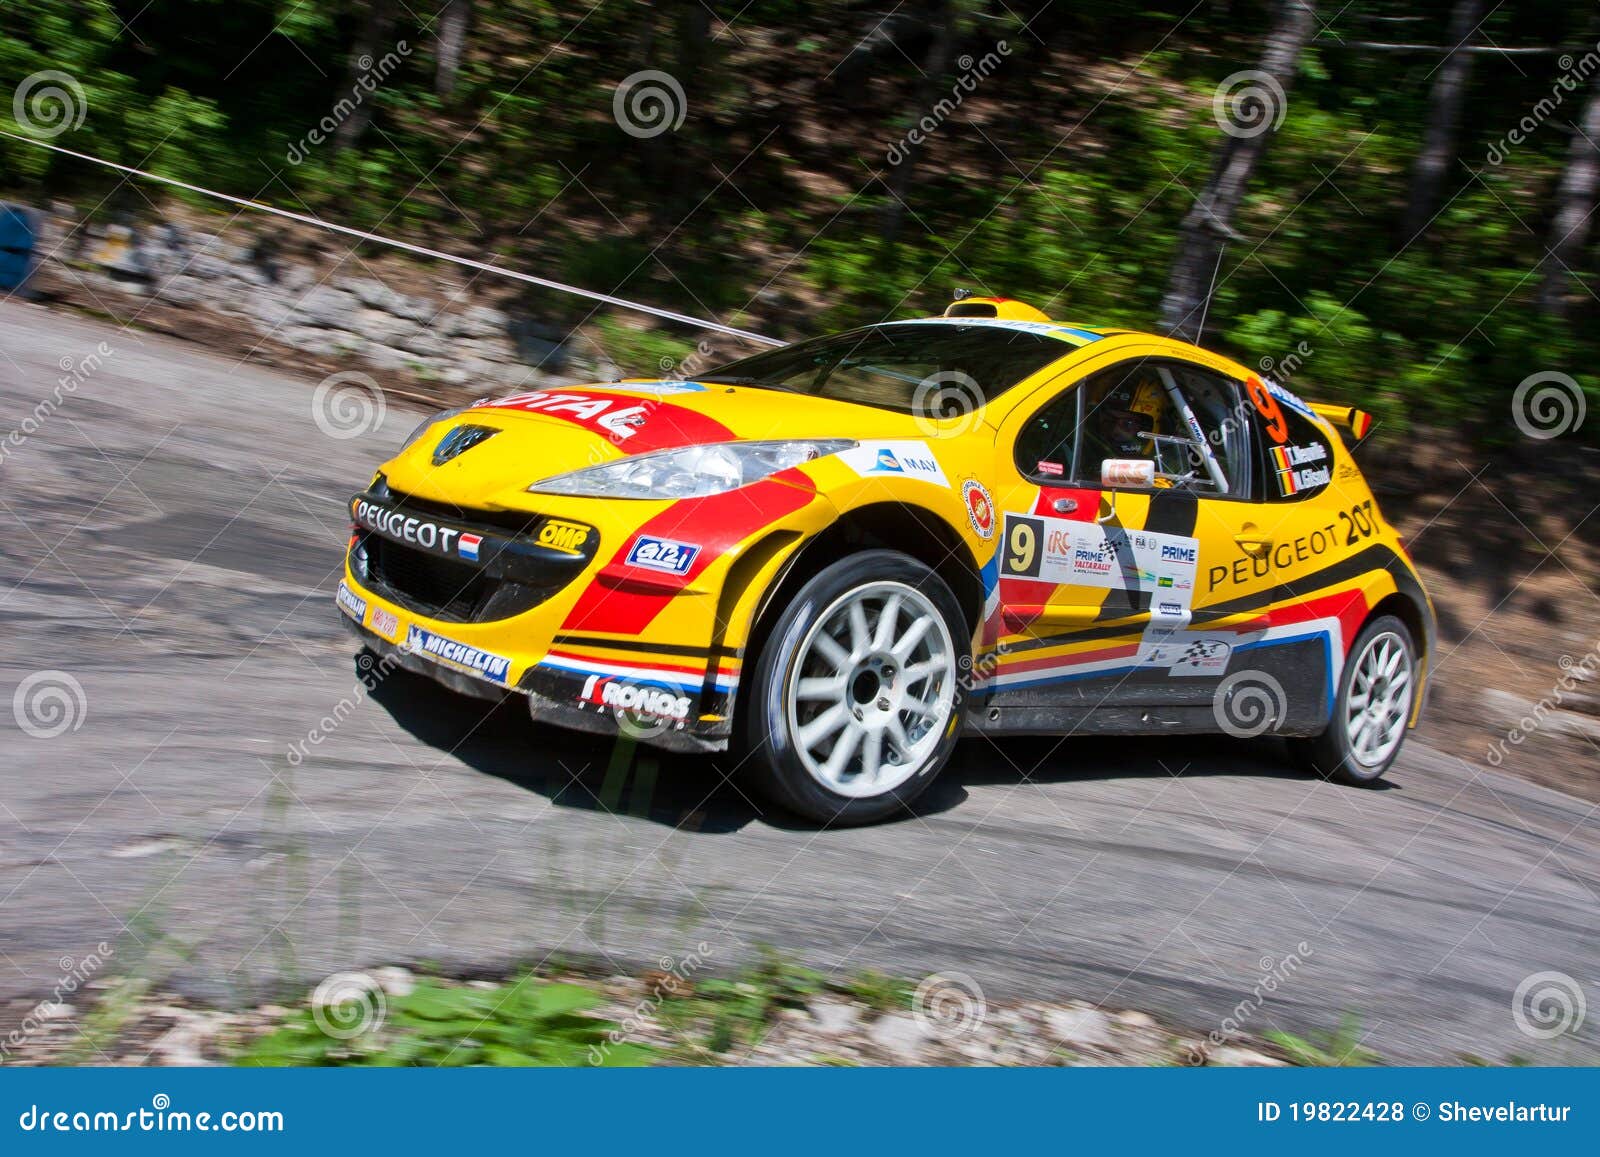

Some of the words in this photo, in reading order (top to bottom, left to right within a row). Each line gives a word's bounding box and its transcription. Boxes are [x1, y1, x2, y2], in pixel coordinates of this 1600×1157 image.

[1246, 376, 1288, 443] 9
[904, 457, 936, 472] MAY
[358, 501, 459, 552] PEUGEOT
[539, 524, 588, 549] OMP
[1010, 523, 1036, 572] 9
[1209, 525, 1338, 592] PEUGEOT
[1339, 500, 1380, 546] 207
[1075, 550, 1103, 562] PRIME
[1161, 545, 1196, 561] PRIME
[424, 634, 511, 678] MICHELIN
